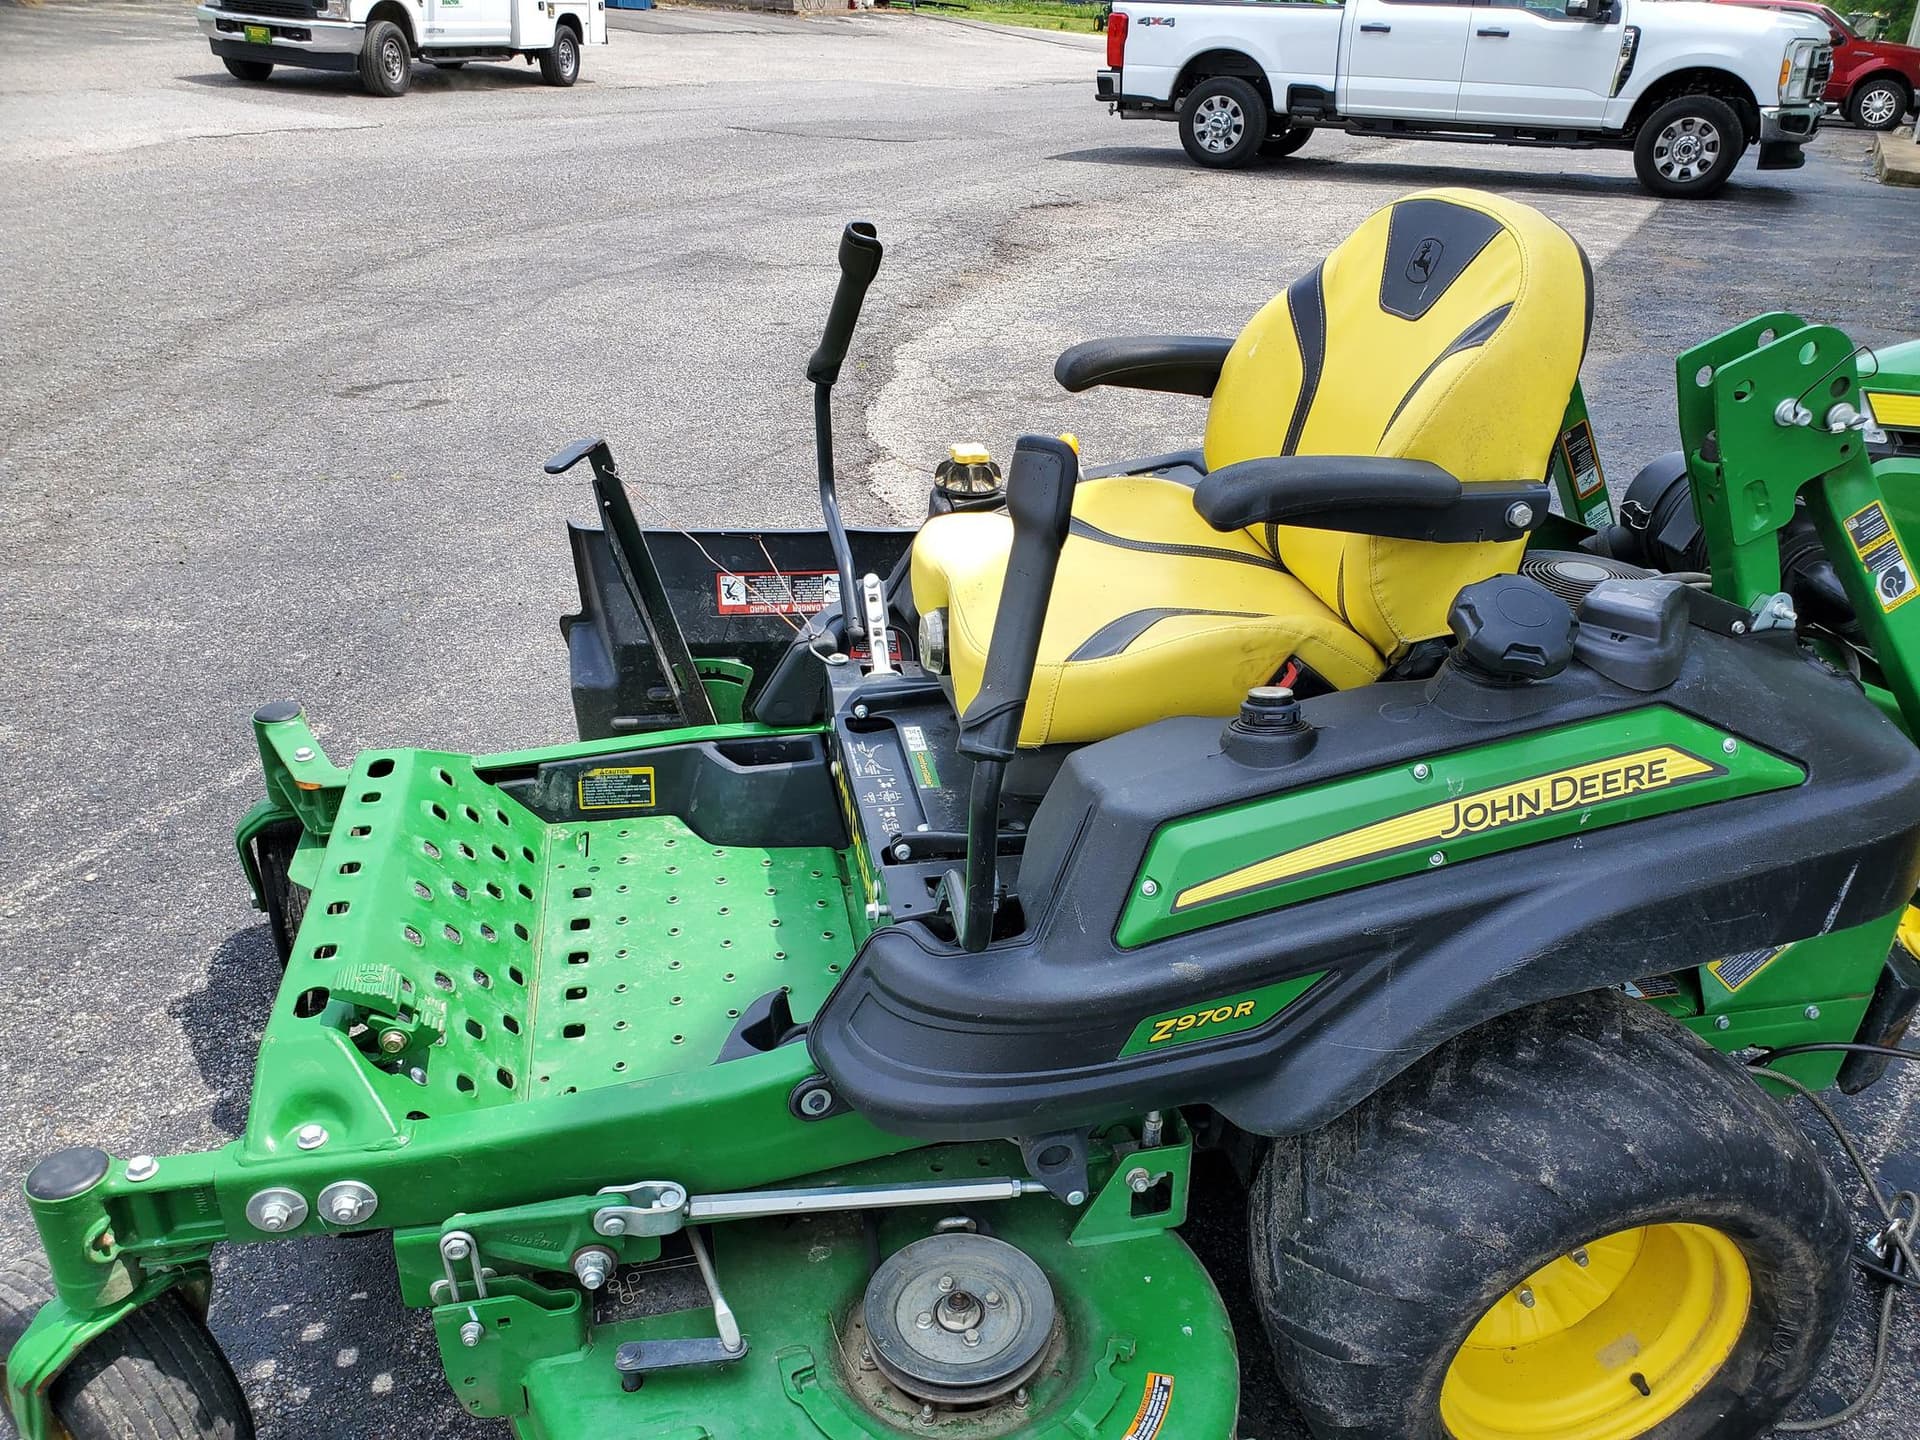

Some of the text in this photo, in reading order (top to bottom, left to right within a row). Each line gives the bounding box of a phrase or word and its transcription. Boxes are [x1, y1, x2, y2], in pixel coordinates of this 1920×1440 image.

[792, 604, 822, 612] DANGER
[1440, 758, 1668, 836] JOHN DEERE
[1149, 1000, 1256, 1043] Z970R
